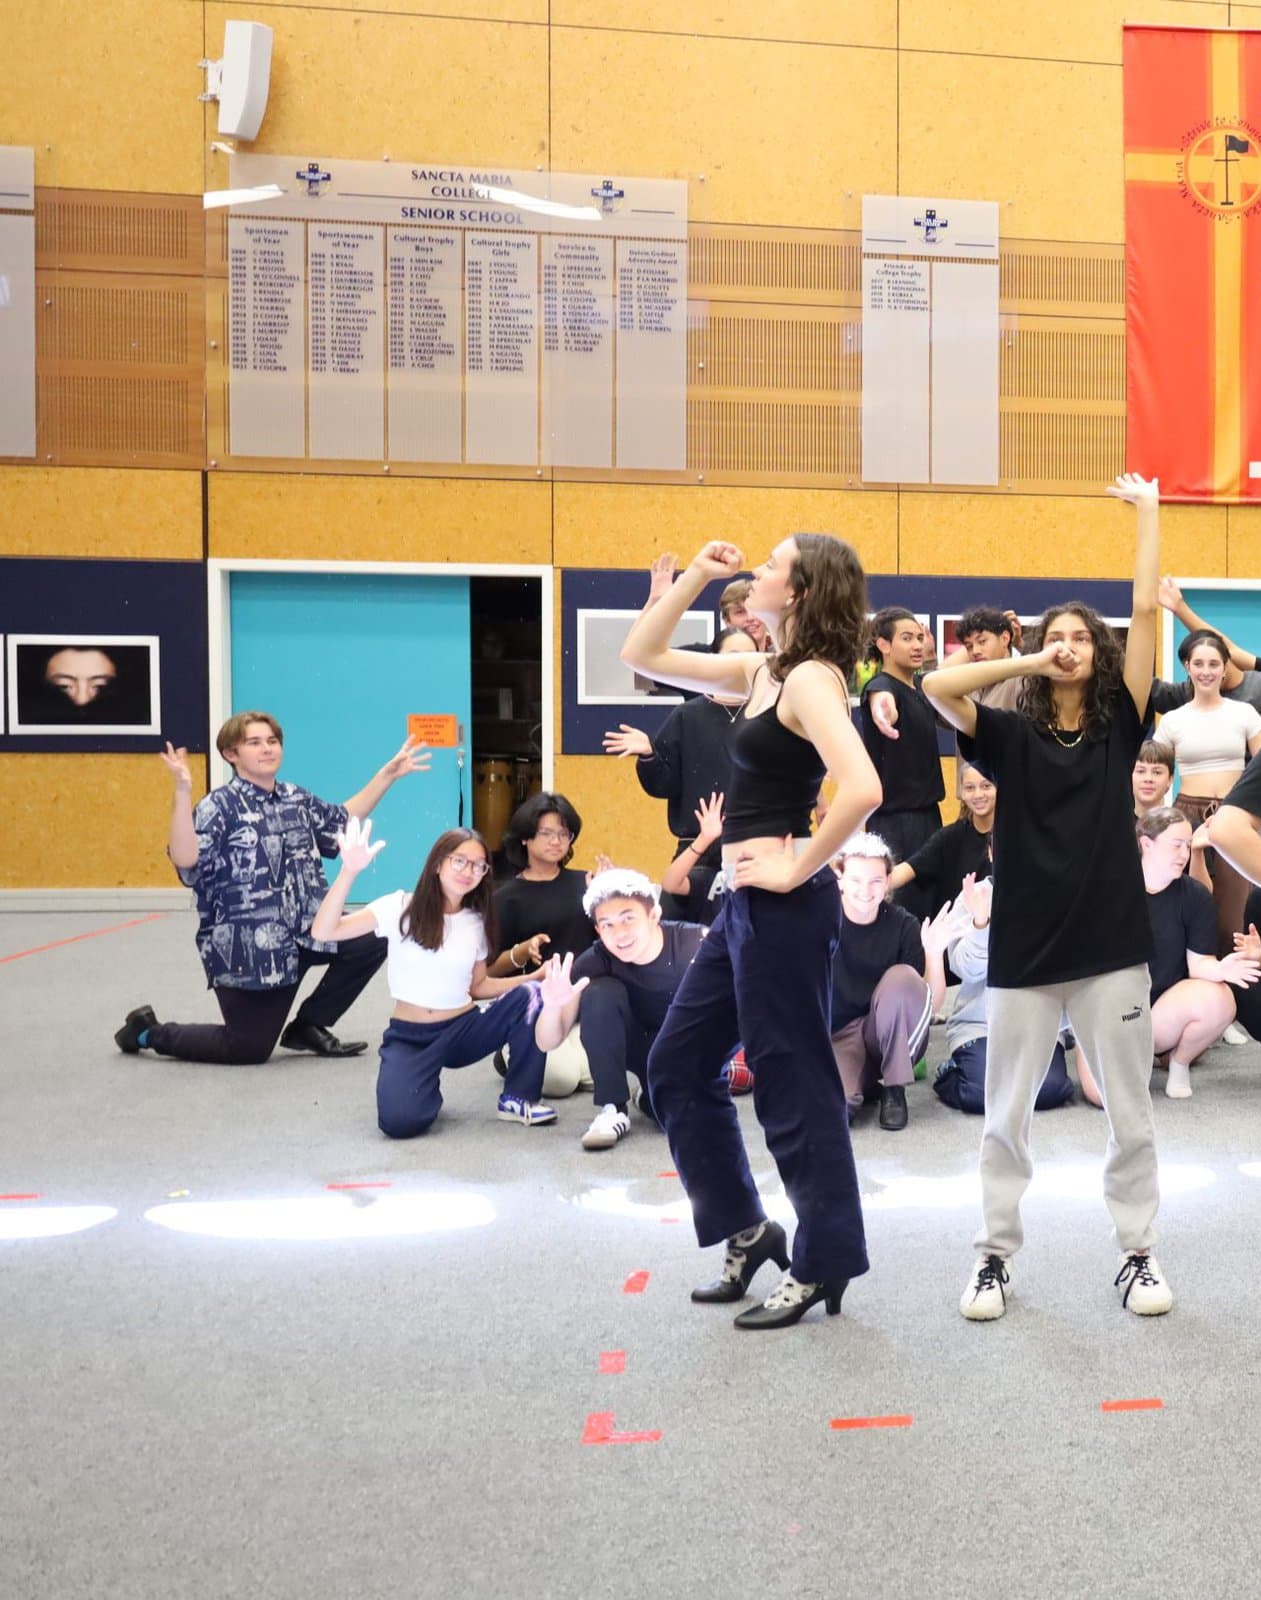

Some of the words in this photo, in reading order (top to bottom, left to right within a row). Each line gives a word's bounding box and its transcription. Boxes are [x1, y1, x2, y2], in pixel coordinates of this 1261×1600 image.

[412, 169, 465, 184] SANCTA
[469, 172, 513, 186] MARIA
[401, 207, 455, 221] SENIOR
[460, 210, 524, 225] SCHOOL
[394, 235, 426, 243] Cultural
[428, 236, 454, 246] Trophy
[471, 239, 503, 247] Cultural
[504, 240, 531, 250] Trophy
[415, 245, 433, 253] Boys
[554, 252, 599, 261] Community
